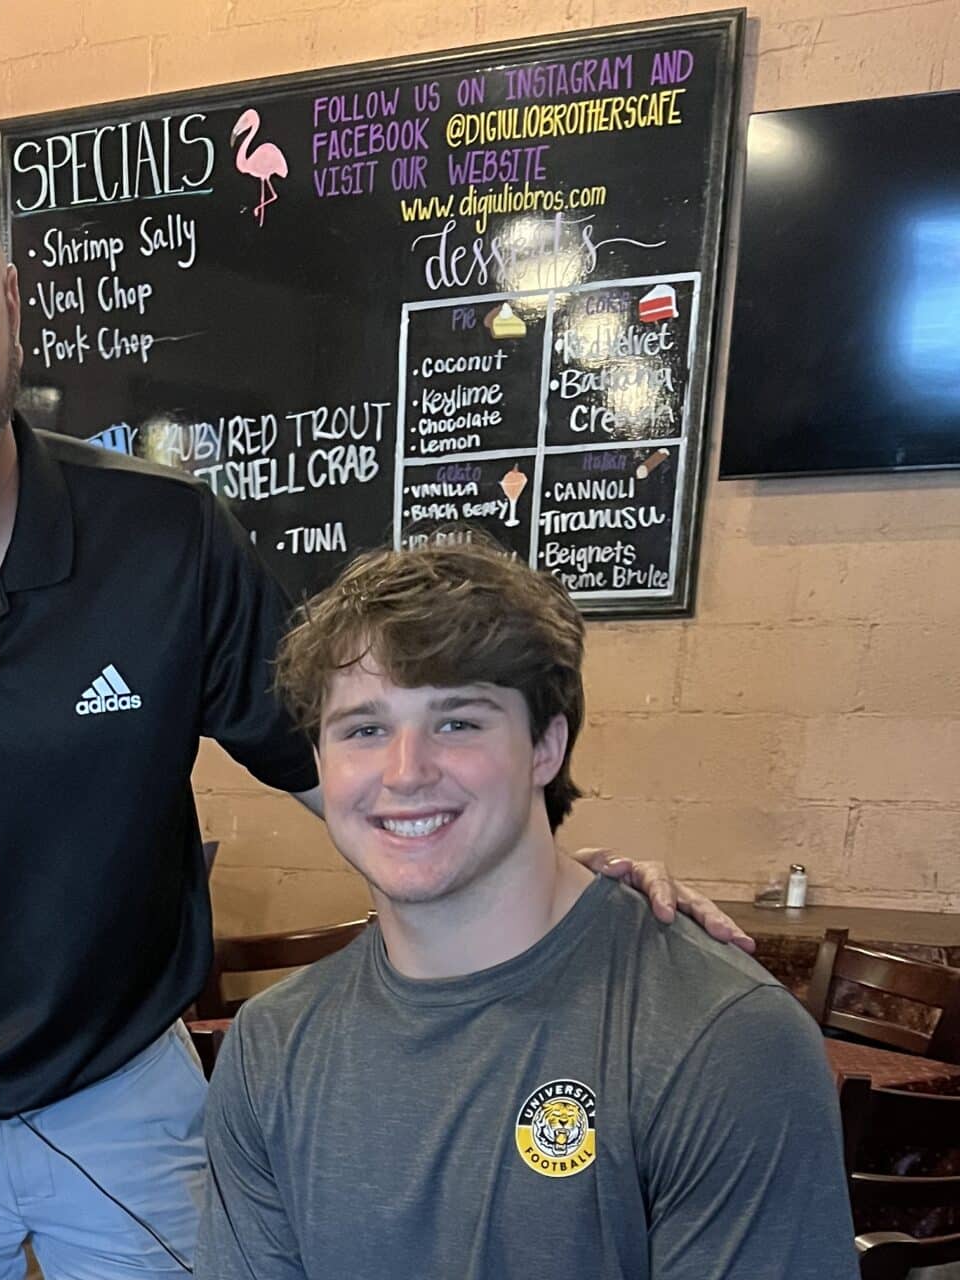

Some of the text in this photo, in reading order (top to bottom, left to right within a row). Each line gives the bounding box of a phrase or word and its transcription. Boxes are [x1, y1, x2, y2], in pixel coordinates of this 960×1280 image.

[314, 49, 694, 127] FOLLOW US ON INSTAGRAM AND
[312, 88, 686, 164] FACEBOOK @DIGIULIOBROTHERSCAFE
[13, 113, 215, 211] SPECIALS
[313, 145, 550, 197] VISIT OUR WEBSITE
[42, 214, 196, 272] Shrimp Sally
[37, 276, 152, 320] Veal Chop
[43, 325, 154, 368] Pork Chop
[421, 349, 508, 378] Coconut
[422, 384, 503, 416] Keylime
[163, 402, 392, 463] RUBY RED TROUT
[418, 410, 502, 436] Chocolate
[420, 434, 480, 454] Lemon
[193, 444, 379, 501] TSHELL CRAB
[411, 482, 478, 498] VANILLA
[554, 477, 634, 502] CANNOLI
[411, 503, 459, 521] BLACK
[284, 522, 348, 554] TUNA
[545, 541, 637, 573] Beignets
[612, 563, 669, 588] Brulee
[75, 693, 142, 715] adidas
[524, 1084, 596, 1118] UNIVERSITY
[525, 1147, 593, 1172] FOOTBALL
